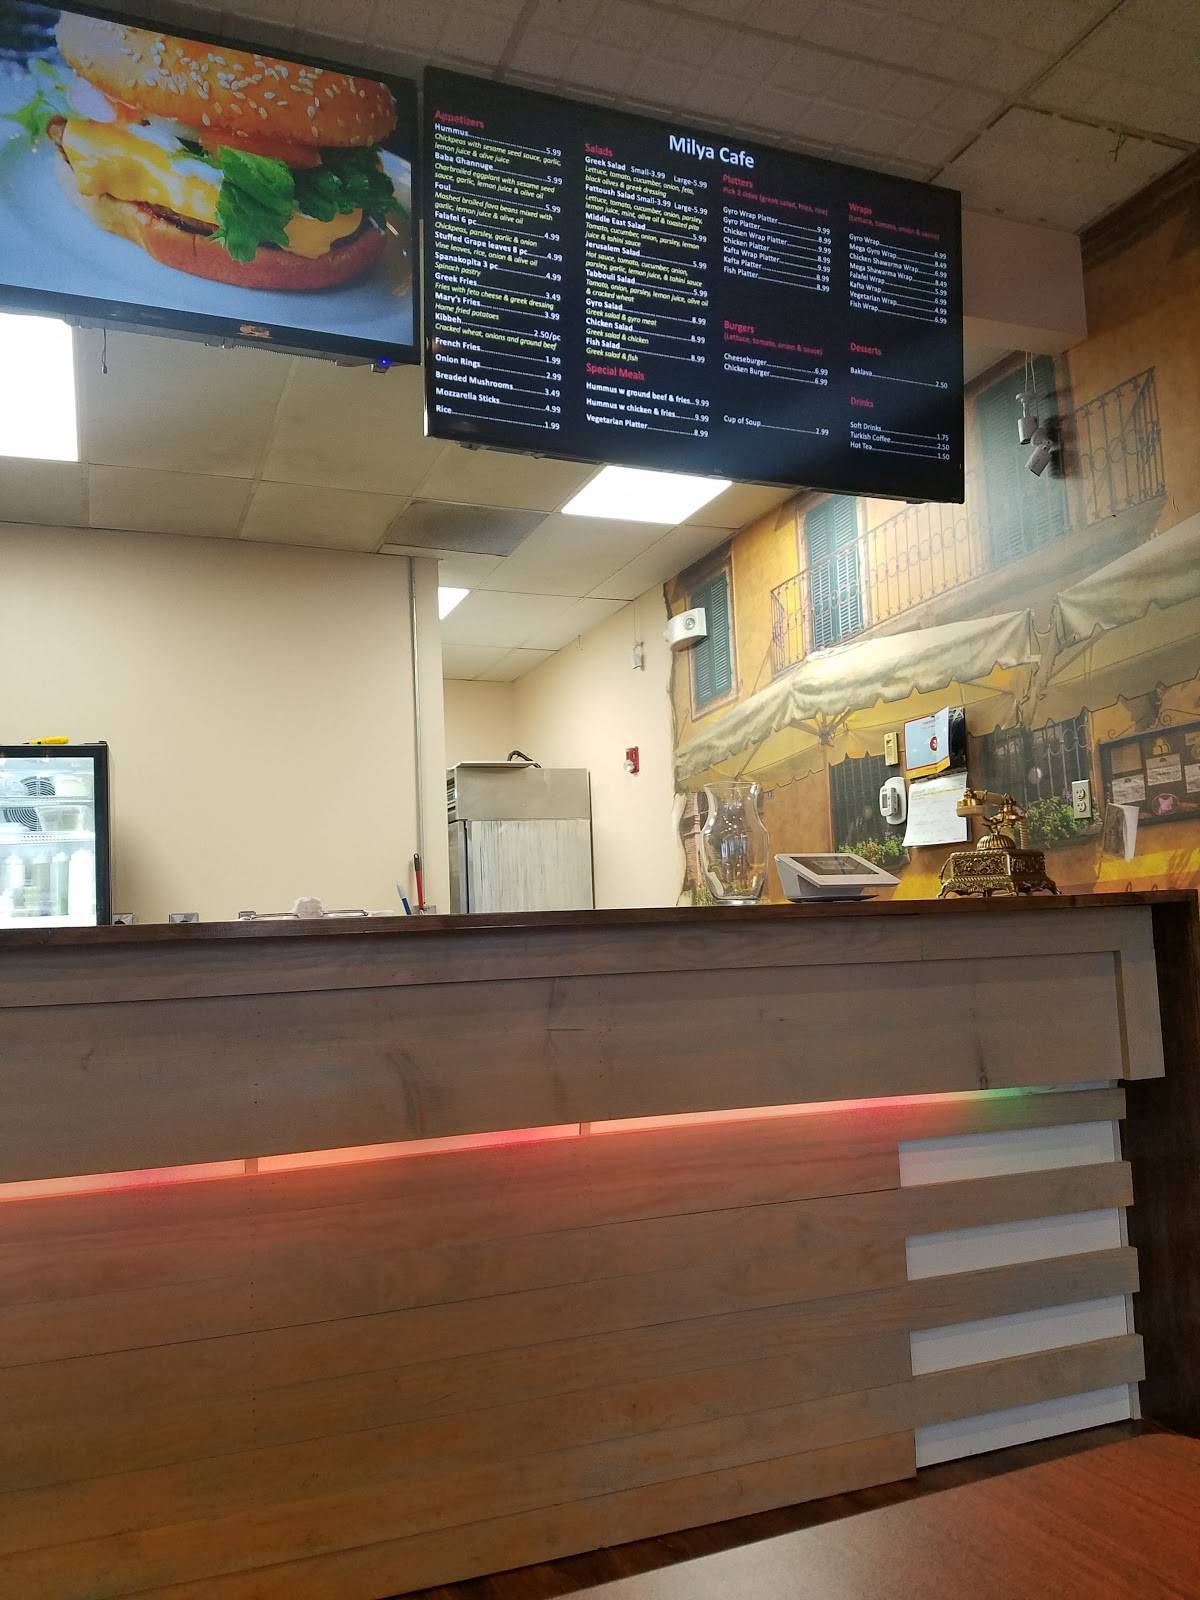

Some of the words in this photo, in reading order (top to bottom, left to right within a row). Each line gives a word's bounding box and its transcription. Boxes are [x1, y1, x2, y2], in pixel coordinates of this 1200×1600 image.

[435, 110, 484, 128] Appetizers
[434, 123, 469, 136] Hummus
[545, 147, 561, 156] 5.99
[585, 143, 612, 156] Salads
[669, 135, 714, 159] Milya
[719, 147, 754, 168] Cafe
[434, 151, 454, 162] Baba
[455, 156, 493, 171] Ghannuge
[546, 175, 562, 185] 5.99
[585, 156, 606, 166] Greek
[607, 160, 626, 171] Salad
[630, 165, 665, 179] Small-3.99
[673, 175, 707, 188] Large-5.99
[722, 174, 752, 188] Platters
[434, 181, 451, 191] Foul
[545, 203, 560, 213] 5.99
[585, 183, 615, 196] Fattoush
[616, 190, 635, 200] Salad
[636, 194, 671, 207] Small-3.99
[674, 202, 707, 215] Large-5.99
[585, 212, 610, 223] Middle
[611, 217, 626, 226] East
[627, 220, 646, 230] Salad
[722, 206, 738, 215] Gyro
[739, 210, 756, 220] Wrap
[757, 213, 778, 223] Platter
[723, 216, 738, 225] Gyro
[739, 219, 760, 229] Platter
[434, 210, 459, 221] Falafel
[544, 232, 560, 241] 4.99
[723, 226, 747, 237] Chicken
[748, 231, 765, 241] Wrap
[766, 235, 788, 245] Platter
[723, 236, 747, 247] Chicken
[748, 241, 769, 251] Platter
[848, 233, 863, 242] Gyro
[863, 236, 880, 246] Wrap
[434, 230, 462, 242] Stuffed
[463, 236, 486, 247] Grape
[488, 240, 511, 252] leaves
[546, 252, 562, 262] 4.99
[585, 240, 620, 252] Jerusalem
[622, 247, 640, 257] Salad
[723, 246, 739, 254] Kafta
[740, 248, 758, 259] Wrap
[759, 252, 780, 262] Platter
[434, 261, 460, 272] Spinach
[460, 267, 481, 277] pastry
[435, 251, 481, 266] Spanakopita
[545, 272, 561, 281] 4.99
[723, 265, 736, 274] Fish
[737, 268, 758, 278] Platter
[434, 272, 458, 282] Greek
[459, 276, 478, 286] Fries
[544, 291, 561, 301] 3.49
[616, 274, 636, 284] Salad
[434, 302, 454, 312] Home
[454, 305, 471, 315] fried
[471, 310, 499, 320] potatoes
[435, 292, 461, 303] Mary's
[462, 296, 480, 306] Fries
[544, 311, 560, 320] 3.99
[585, 297, 603, 307] Gyro
[604, 301, 623, 311] Salad
[435, 312, 461, 323] Kibbeh
[533, 329, 560, 341] 2.50/pc
[585, 317, 613, 328] Chicken
[614, 322, 633, 332] Salad
[724, 320, 754, 333] Burgers
[585, 337, 600, 346] Fish
[601, 339, 620, 349] Salad
[586, 327, 603, 336] Greek
[604, 331, 621, 339] salad
[627, 335, 649, 344] chicken
[435, 336, 461, 347] French
[462, 341, 481, 351] Fries
[545, 355, 561, 364] 1.99
[850, 342, 881, 355] Desserts
[435, 353, 458, 363] Onion
[460, 357, 481, 368] Rings
[545, 371, 561, 380] 2.99
[724, 352, 767, 366] Cheeseburger
[586, 363, 617, 376] Special
[618, 368, 644, 380] Meals
[723, 363, 748, 373] Chicken
[749, 367, 770, 377] Burger
[850, 366, 872, 376] Baklava
[435, 370, 467, 382] Breaded
[469, 376, 513, 390] Mushrooms
[544, 388, 560, 397] 3.49
[435, 387, 477, 400] Mozzarella
[478, 394, 500, 404] Sticks
[544, 404, 561, 413] 4.99
[586, 382, 617, 393] Hummus
[626, 389, 650, 398] ground
[651, 391, 667, 400] beef
[675, 395, 690, 404] fries
[850, 396, 873, 407] Drinks
[586, 398, 617, 409] Hummus
[626, 404, 652, 414] chicken
[660, 408, 676, 417] fries
[435, 404, 452, 414] Rice
[544, 421, 560, 430] 1.99
[586, 413, 623, 425] Vegetarian
[624, 419, 648, 429] Platter
[723, 414, 736, 424] Cup
[745, 417, 762, 427] Soup
[850, 421, 862, 429] Soft
[863, 422, 882, 431] Drinks
[850, 430, 871, 440] Turkish
[872, 434, 890, 442] Coffee
[862, 442, 872, 450] Tea
